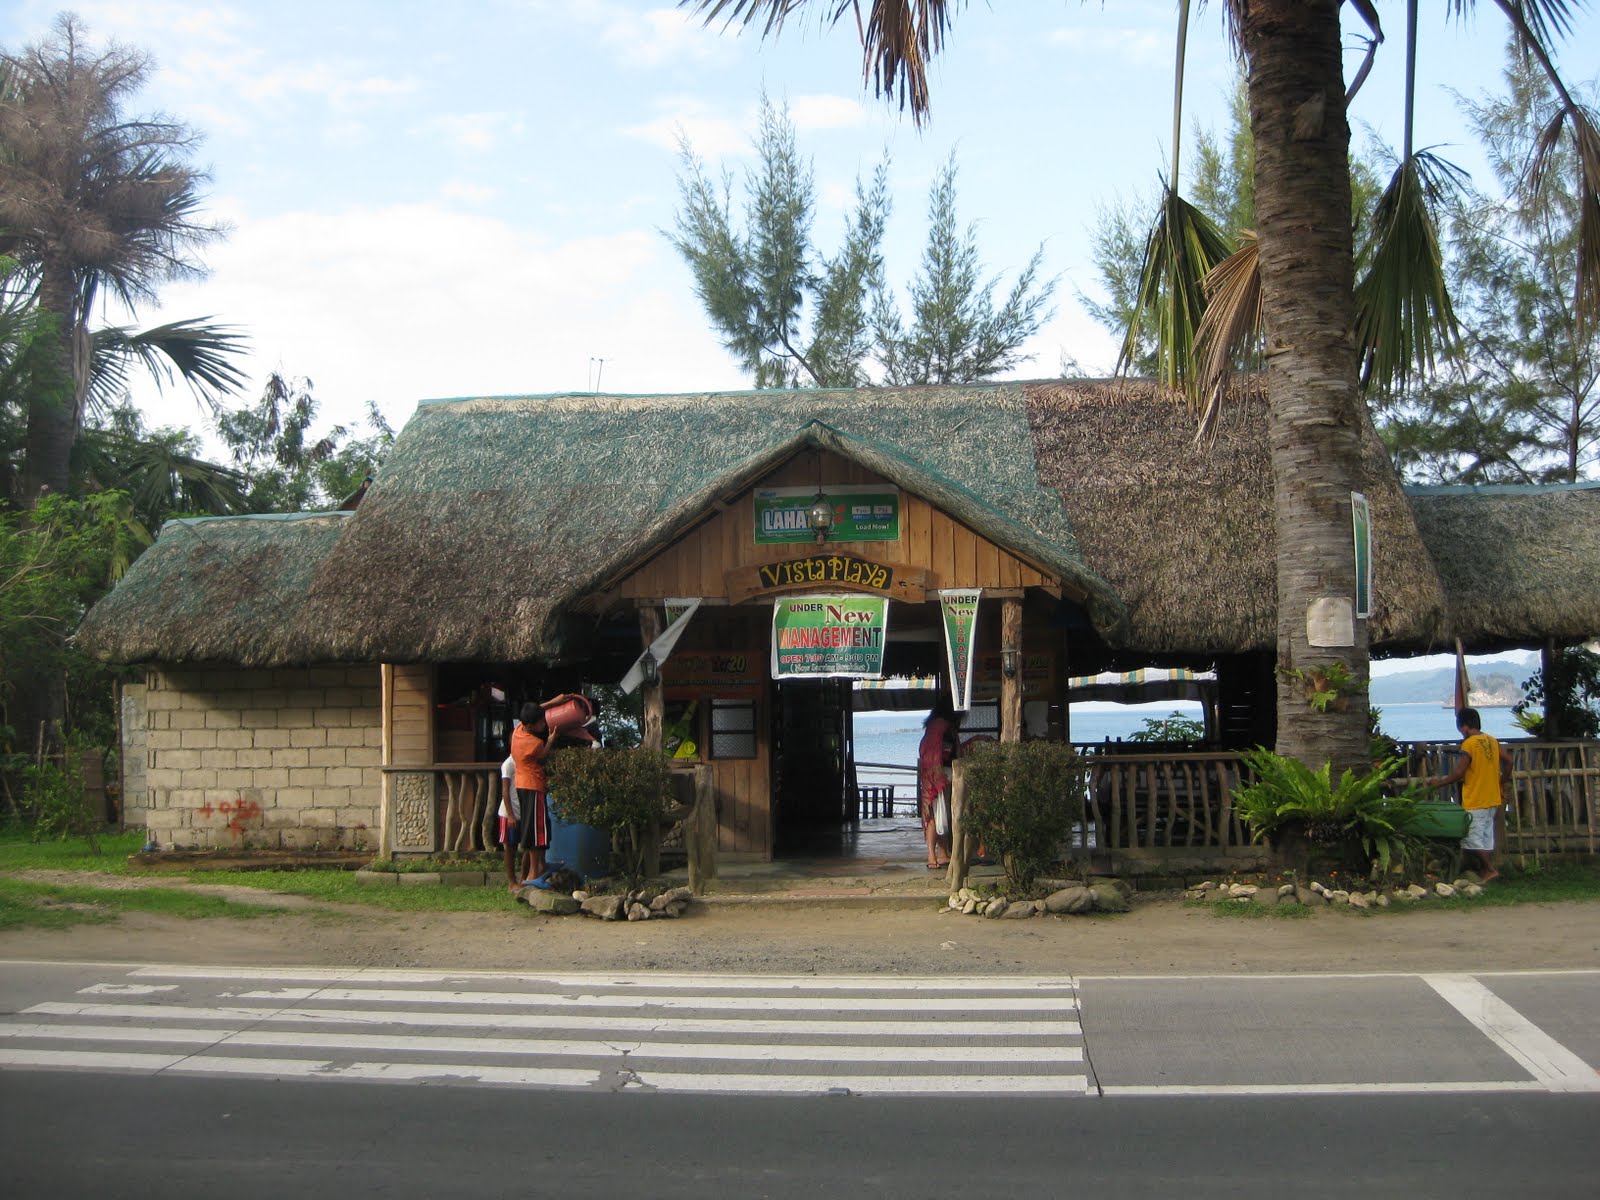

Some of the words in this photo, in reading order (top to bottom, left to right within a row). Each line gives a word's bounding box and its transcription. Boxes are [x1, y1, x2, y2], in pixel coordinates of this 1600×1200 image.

[827, 556, 887, 588] Playa
[943, 595, 978, 605] UNDER
[789, 603, 823, 613] UNDER
[825, 604, 874, 624] New
[947, 605, 976, 617] New
[778, 626, 882, 648] MANAGEMENT
[780, 654, 804, 664] OPEN
[804, 654, 824, 663] 7:00
[825, 653, 839, 663] AM
[864, 653, 879, 663] PM
